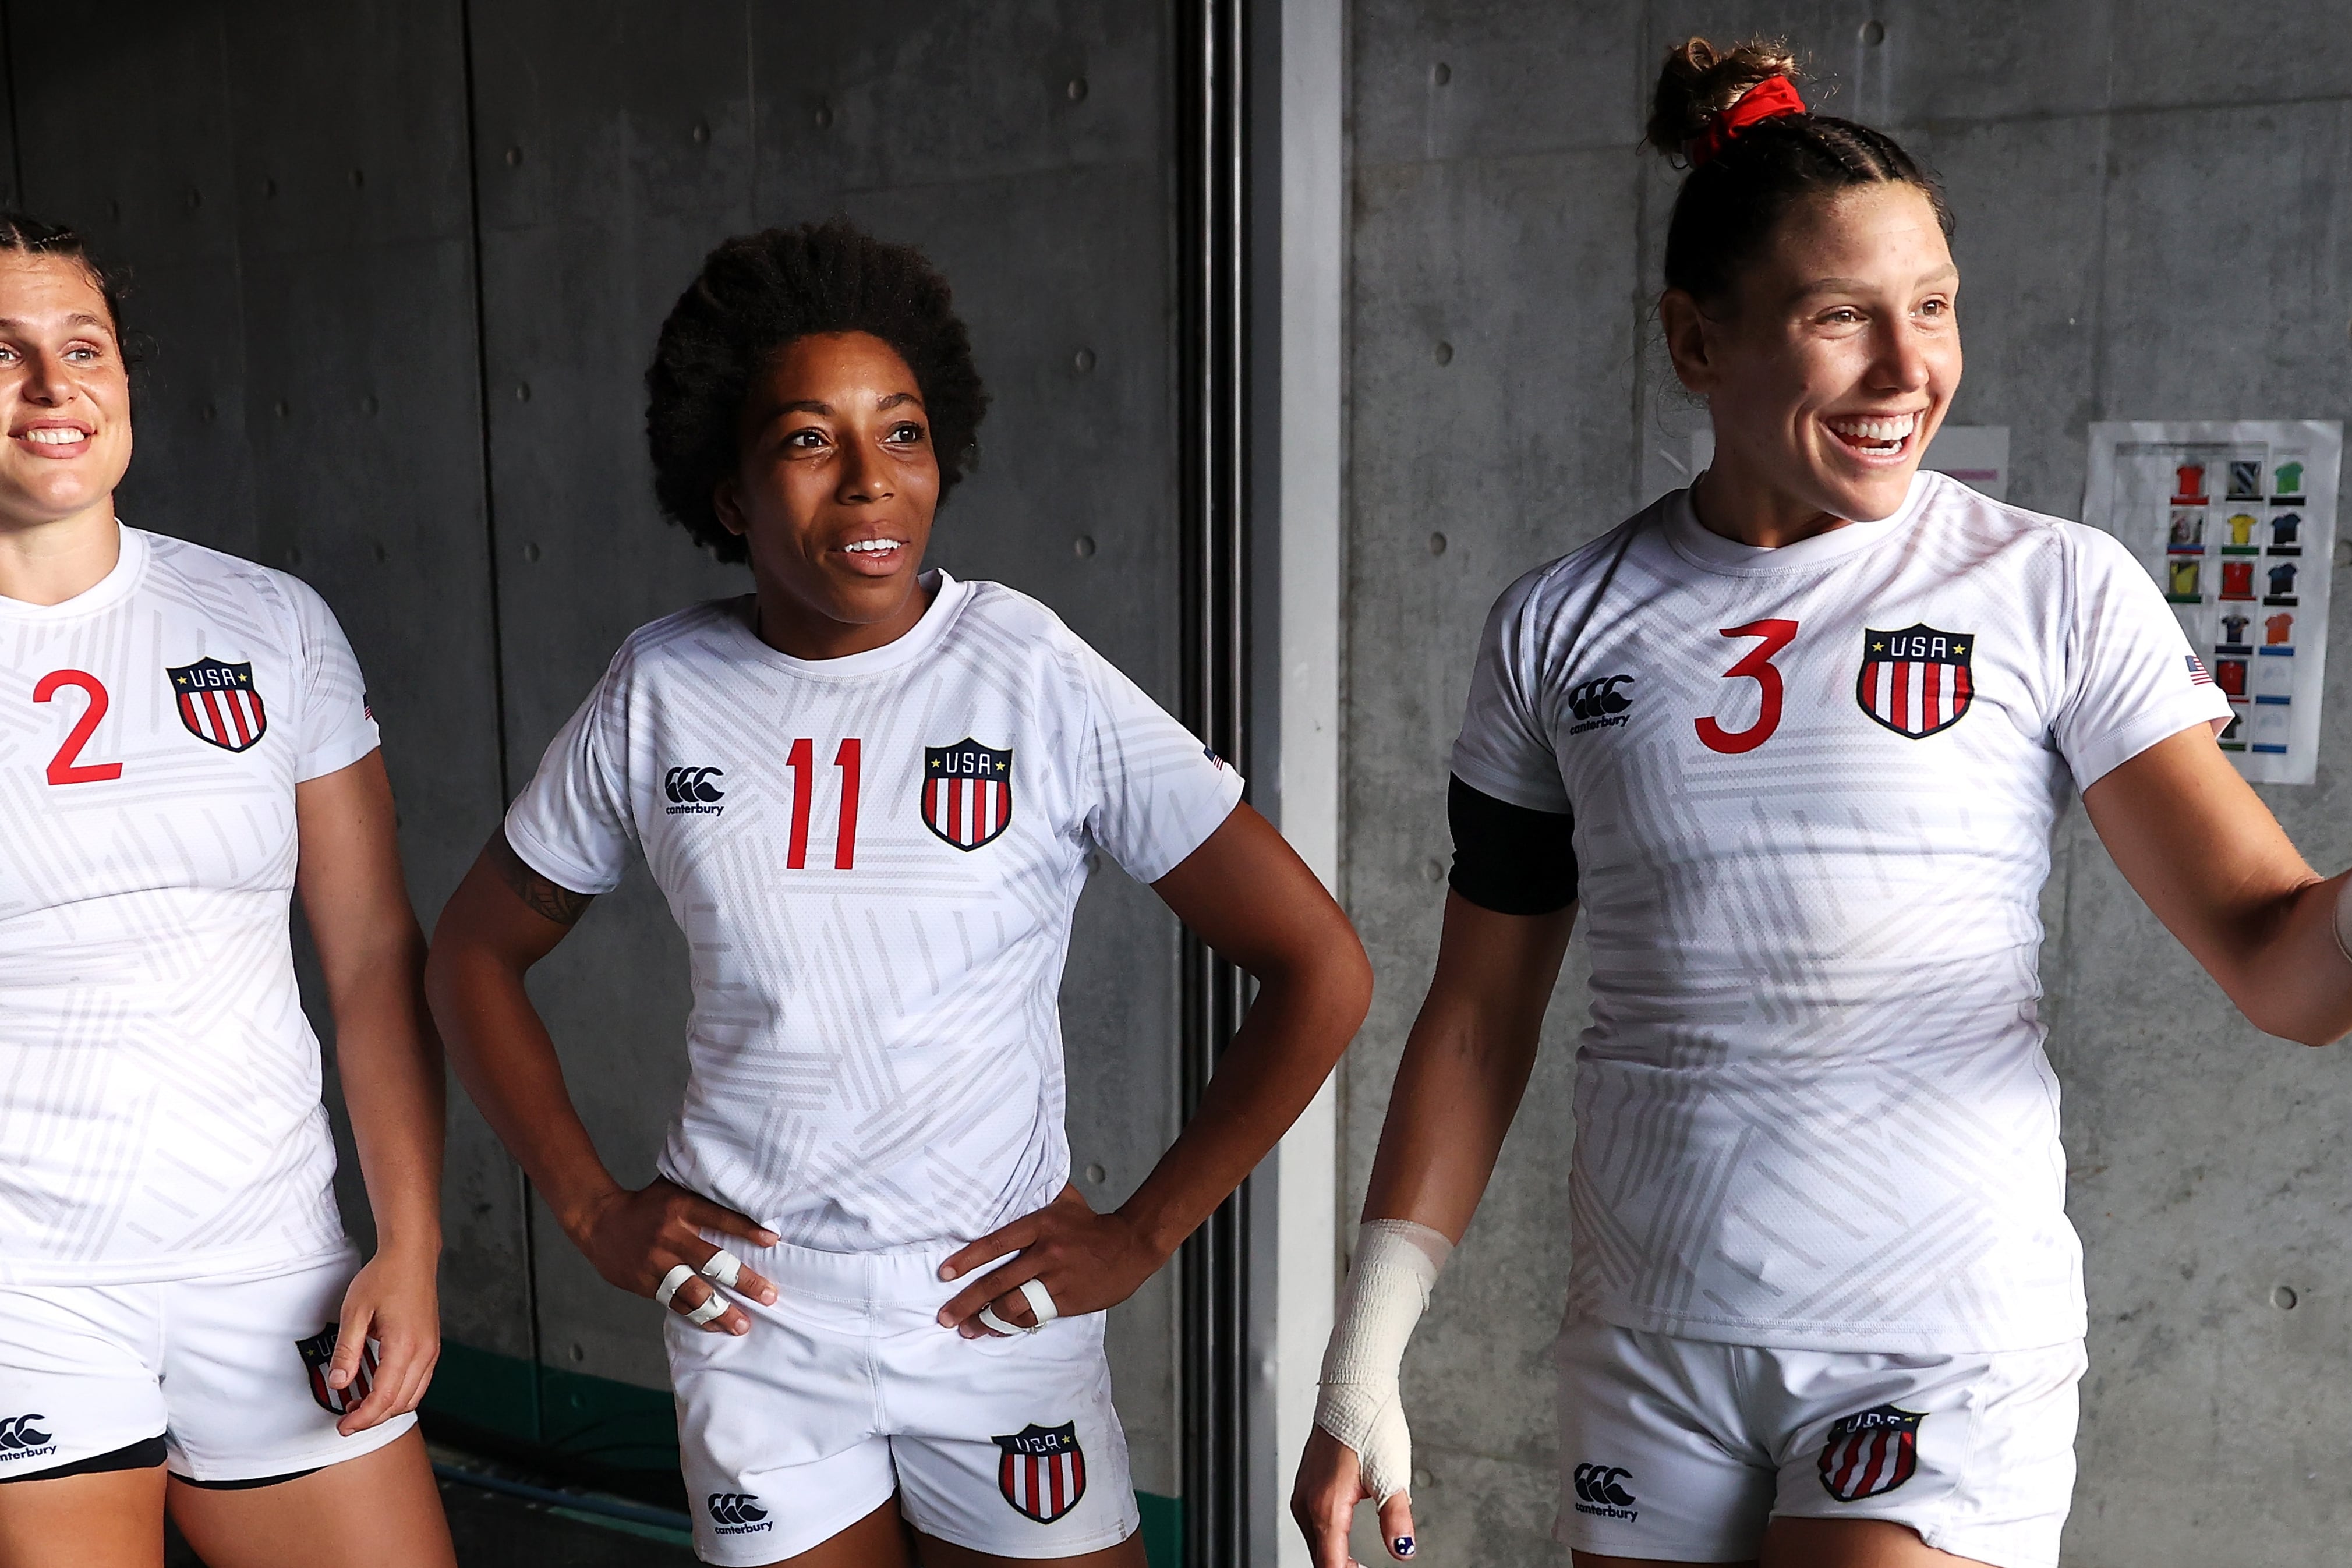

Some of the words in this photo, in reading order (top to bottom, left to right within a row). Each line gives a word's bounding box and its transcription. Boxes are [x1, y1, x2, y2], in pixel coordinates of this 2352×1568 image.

[1891, 636, 1947, 659] USA
[189, 667, 236, 688] USA
[1694, 618, 1799, 754] 3
[33, 669, 123, 785] 2
[1570, 714, 1630, 735] canterbury
[946, 752, 991, 775] USA
[666, 802, 724, 817] canterbury
[786, 738, 861, 869] 11
[0, 1445, 57, 1461] nterbury
[1575, 1502, 1638, 1523] canterbury
[715, 1521, 773, 1534] canterbury
